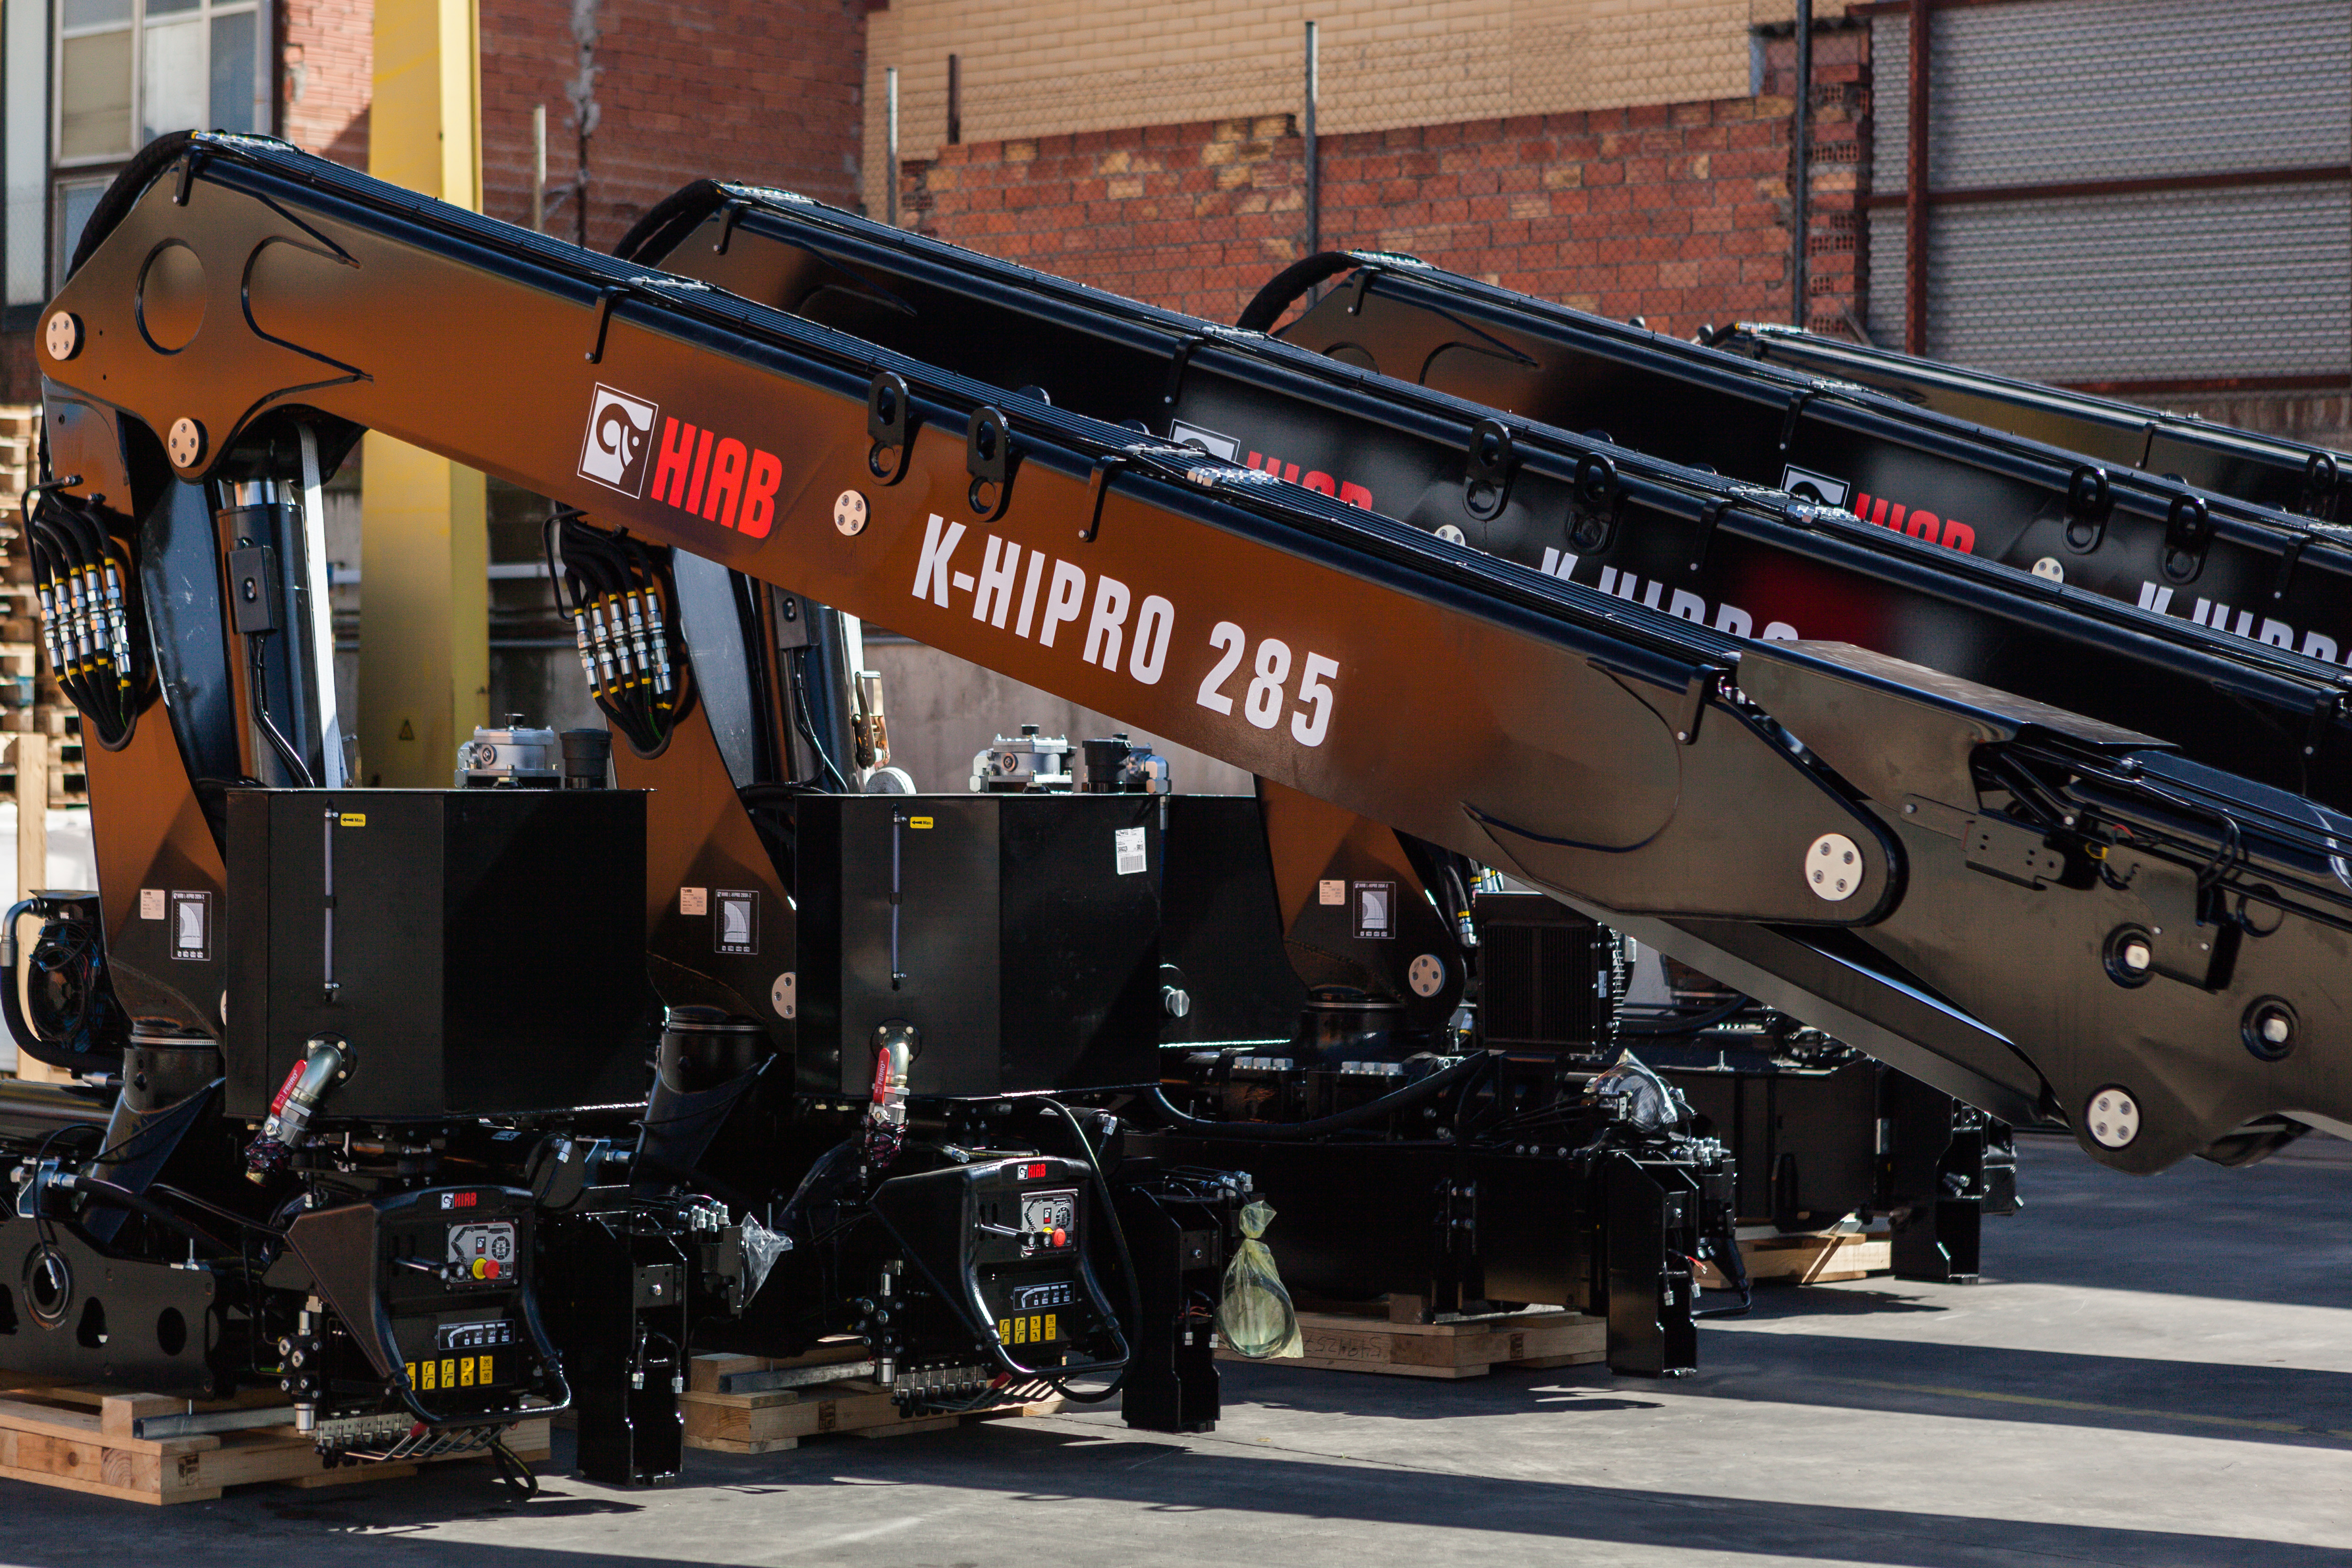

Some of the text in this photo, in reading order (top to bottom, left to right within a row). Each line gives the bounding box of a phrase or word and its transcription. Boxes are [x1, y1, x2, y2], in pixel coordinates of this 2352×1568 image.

[651, 417, 782, 539] HIAB
[912, 513, 1339, 747] K-HIPRO 285
[454, 1192, 477, 1207] HIAB
[1028, 1164, 1046, 1178] HIAB
